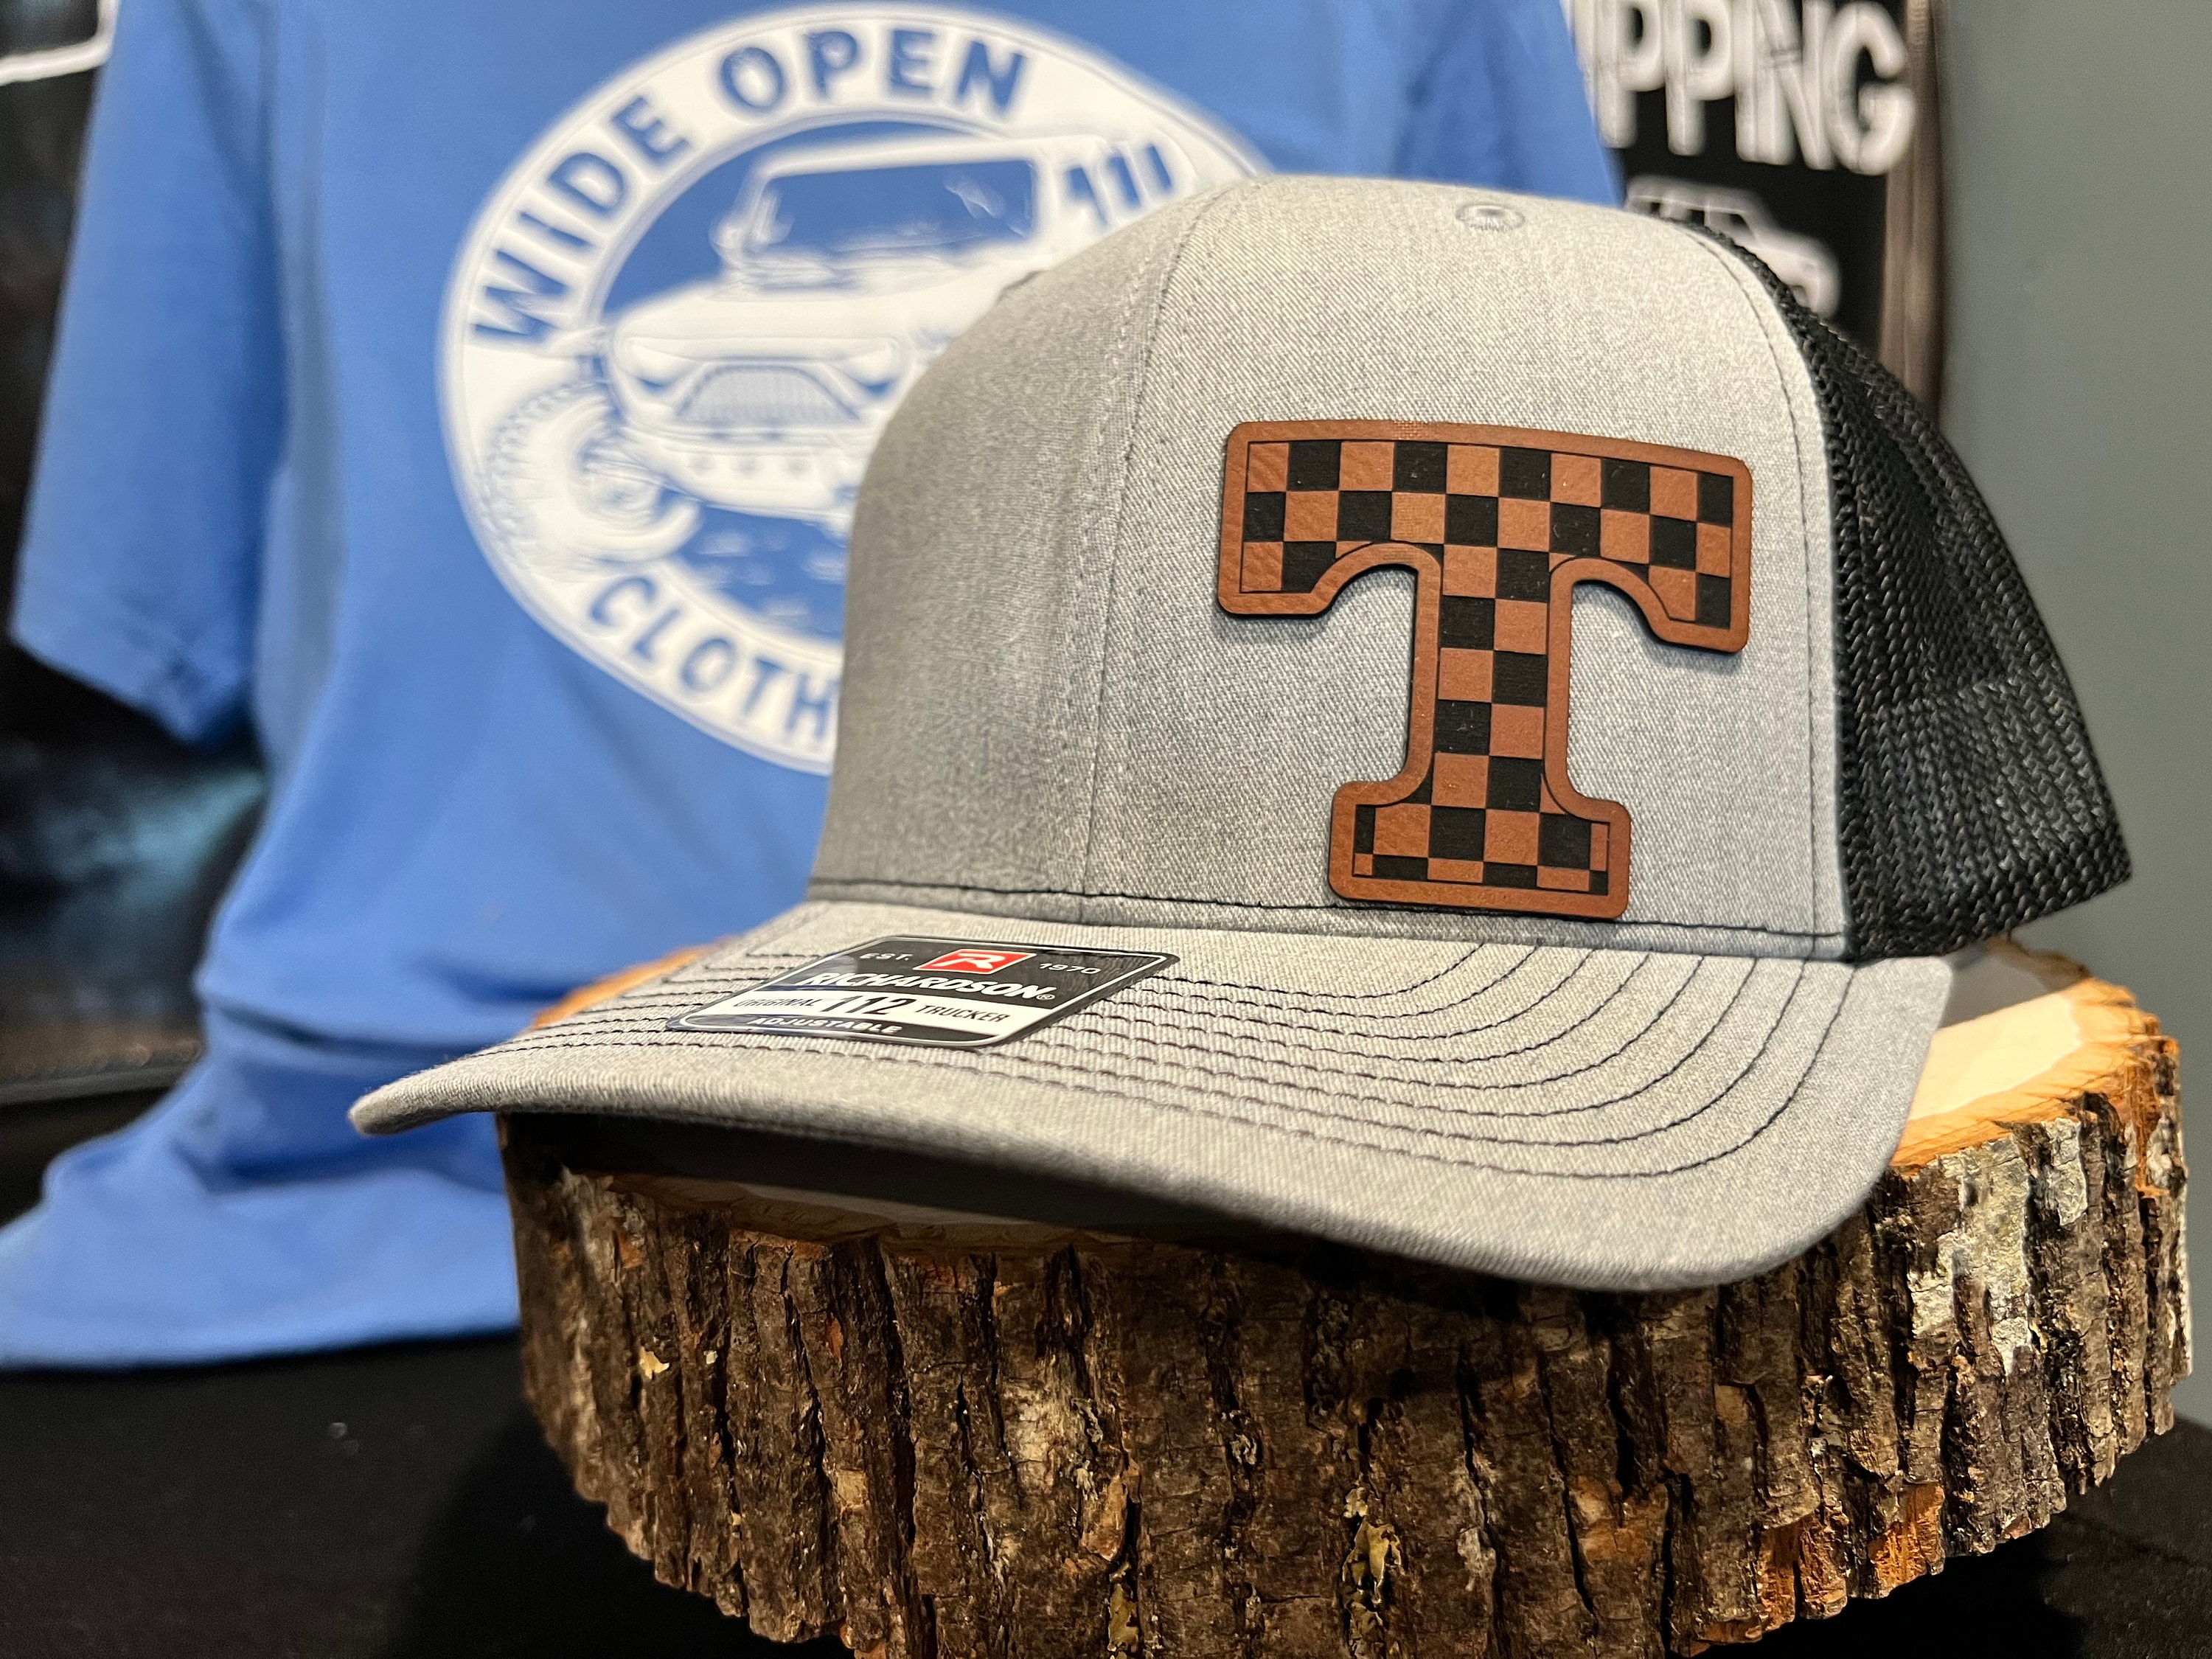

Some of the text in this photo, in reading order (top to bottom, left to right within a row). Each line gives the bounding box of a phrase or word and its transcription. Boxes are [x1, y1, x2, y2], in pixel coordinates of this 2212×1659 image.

[470, 28, 1027, 345] WIDE OPEN
[588, 577, 838, 740] CLOTH
[858, 952, 1102, 975] EST. 1970
[819, 995, 917, 1015] 112
[914, 1004, 1011, 1023] TRUCKER
[746, 1017, 903, 1034] ADJUSTABLE
